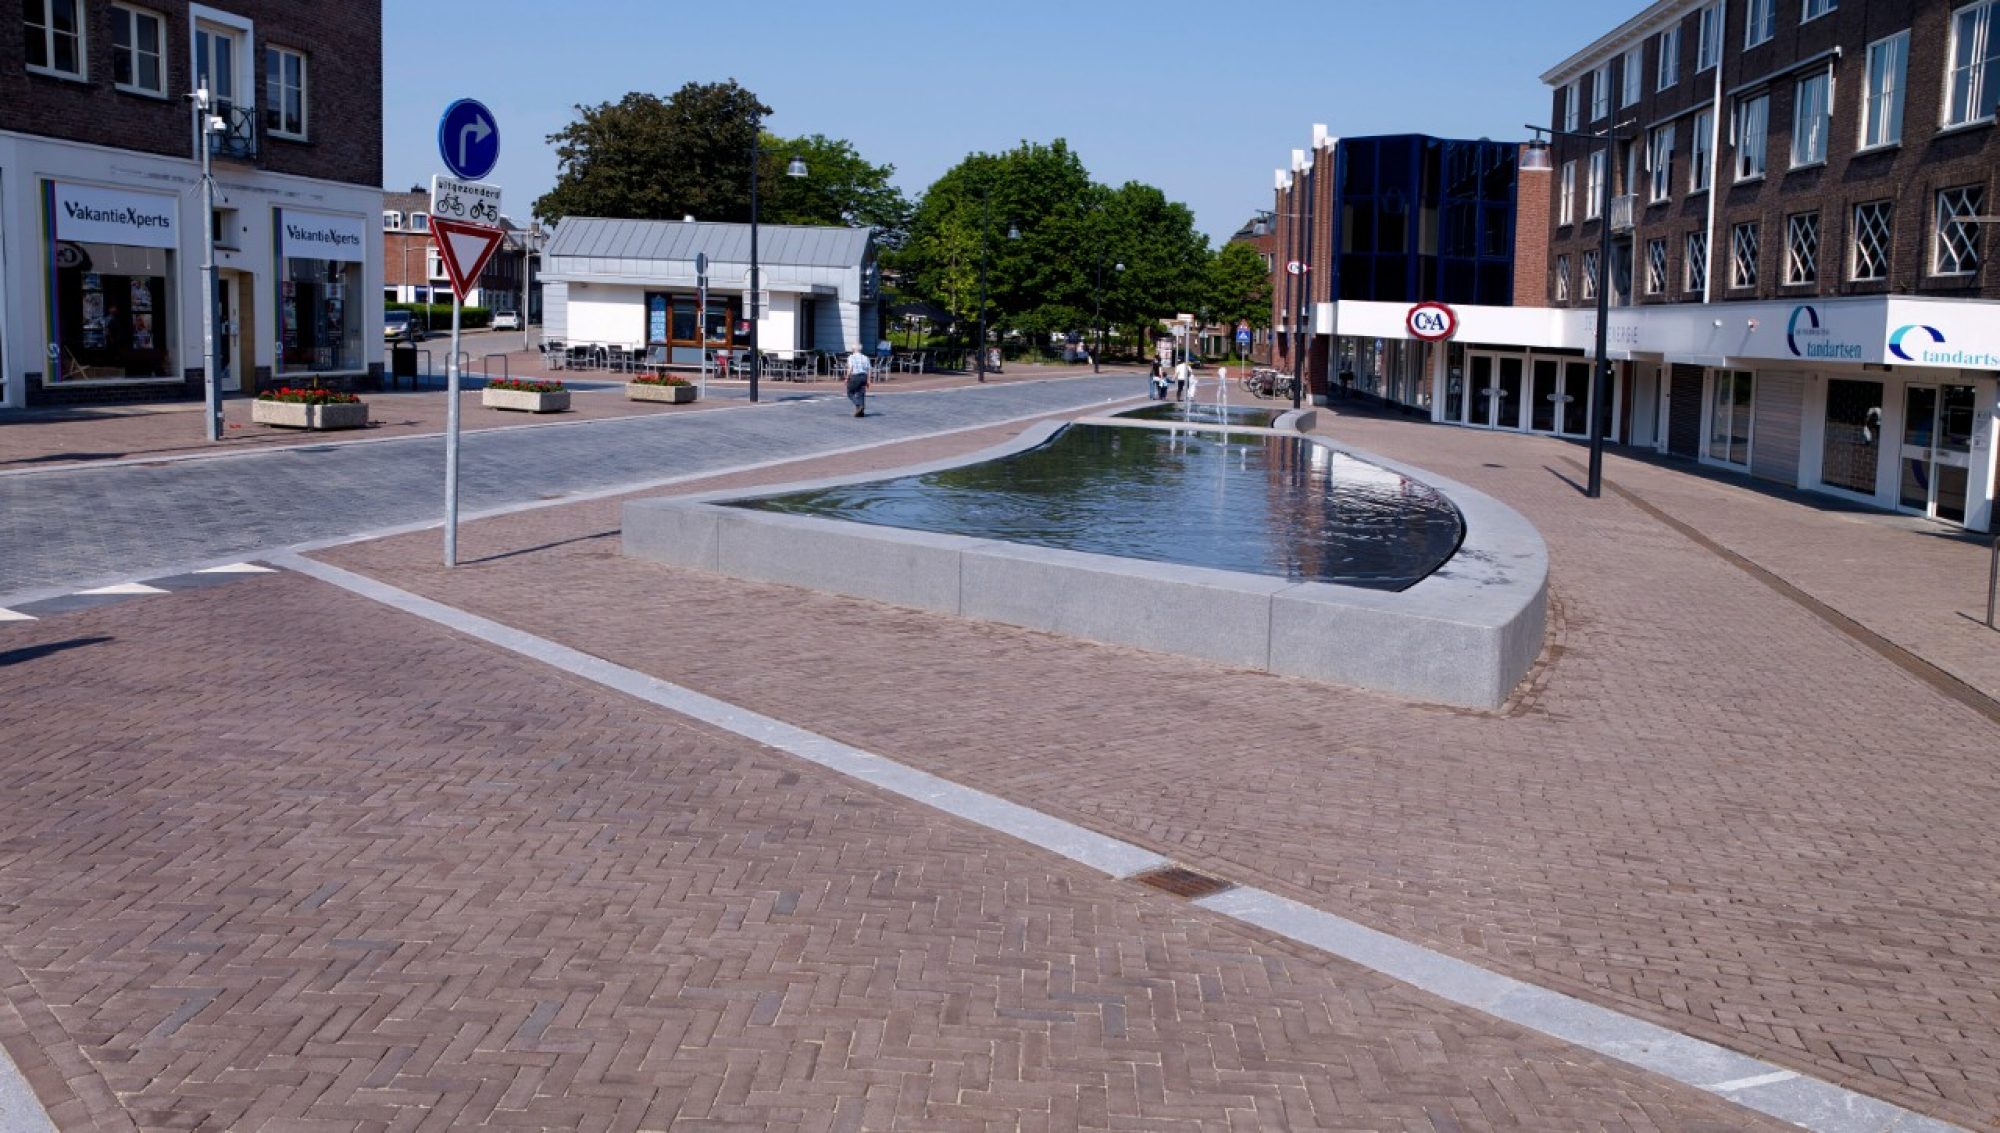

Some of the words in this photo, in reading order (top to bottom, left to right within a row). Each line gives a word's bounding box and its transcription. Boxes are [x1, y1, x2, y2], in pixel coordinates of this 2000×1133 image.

[438, 181, 501, 200] uitgezonderd
[64, 200, 170, 229] VakantieXperts
[286, 224, 360, 247] VakantieXperts
[1413, 311, 1446, 331] C&A
[1807, 339, 1862, 359] tandartsen
[1922, 349, 2000, 366] tandarts
